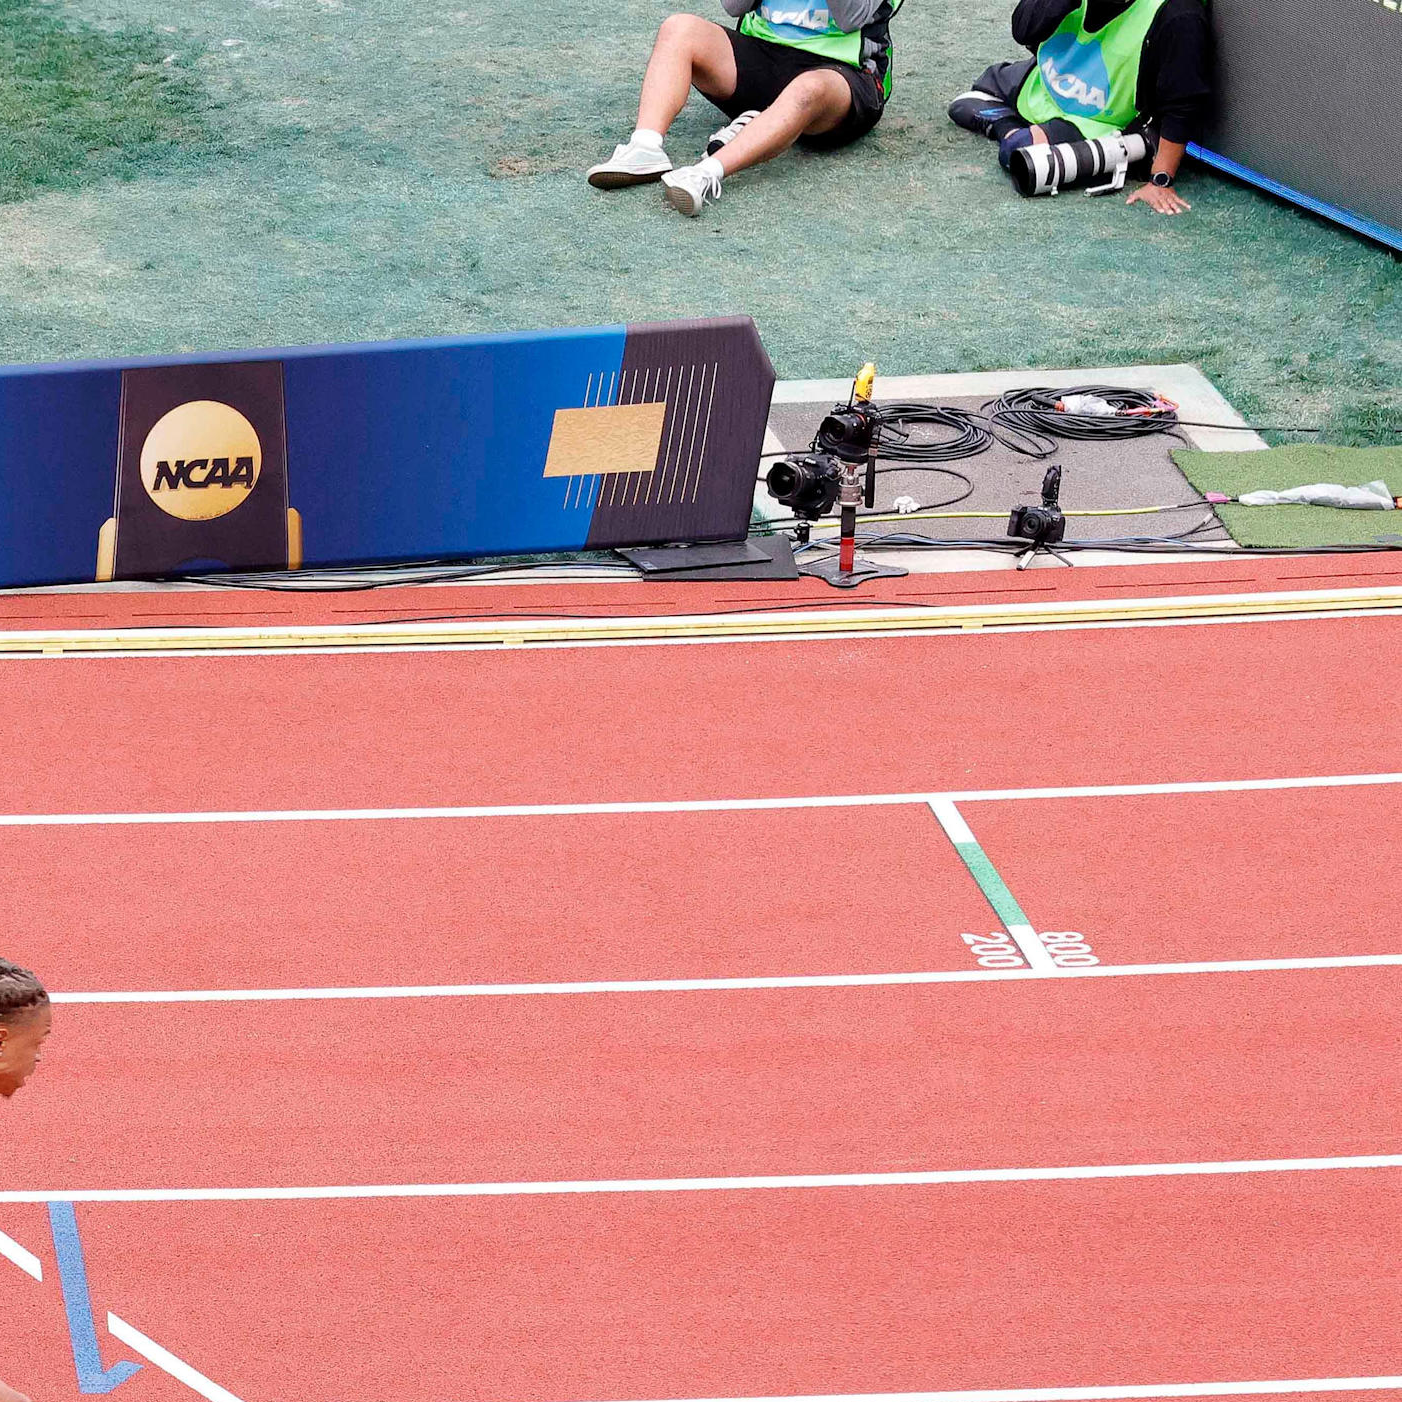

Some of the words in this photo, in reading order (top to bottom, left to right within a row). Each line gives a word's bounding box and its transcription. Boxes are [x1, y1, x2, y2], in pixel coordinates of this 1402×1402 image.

[1042, 57, 1106, 109] NCAA
[152, 456, 255, 493] NCAA
[960, 931, 1025, 968] 200
[1037, 930, 1101, 967] 800
